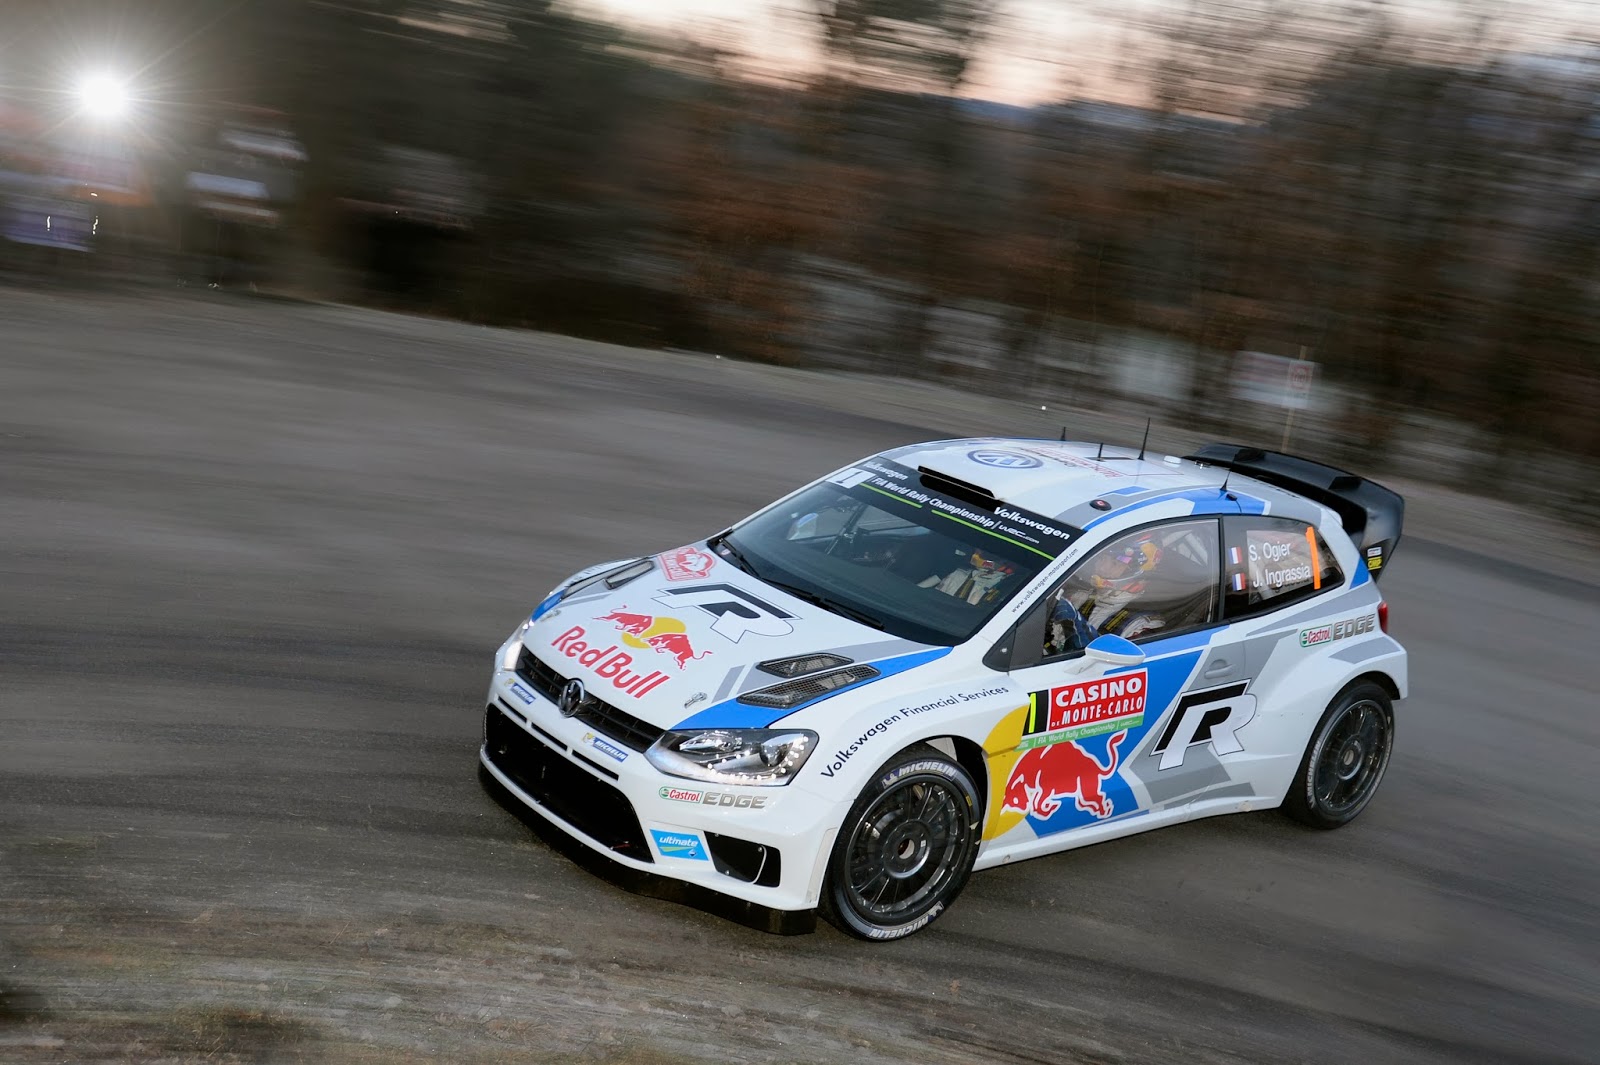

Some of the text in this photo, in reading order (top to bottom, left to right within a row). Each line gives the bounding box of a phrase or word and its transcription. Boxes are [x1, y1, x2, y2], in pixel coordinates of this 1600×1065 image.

[872, 477, 994, 527] FIA World Rally Championship
[994, 506, 1071, 540] Volkswagen
[1248, 541, 1292, 562] S. Ogier
[1305, 526, 1321, 590] 1
[1252, 570, 1263, 588] J.
[1265, 563, 1312, 588] Ingrassia
[1307, 613, 1376, 644] Castrol EDGE
[551, 625, 671, 699] Red Bull
[1055, 677, 1143, 708] CASINO
[1061, 696, 1143, 725] MONTE-CARLO
[821, 685, 1009, 779] Volkswagen Financial Services
[1048, 732, 1066, 742] World
[1065, 730, 1079, 740] Rally
[1080, 723, 1116, 736] Championship
[596, 740, 627, 760] MICHELIN
[899, 760, 957, 779] MICHELIN
[669, 789, 768, 809] Castrol EDGE
[659, 835, 699, 848] ultimate
[870, 915, 929, 938] MICHELIN
